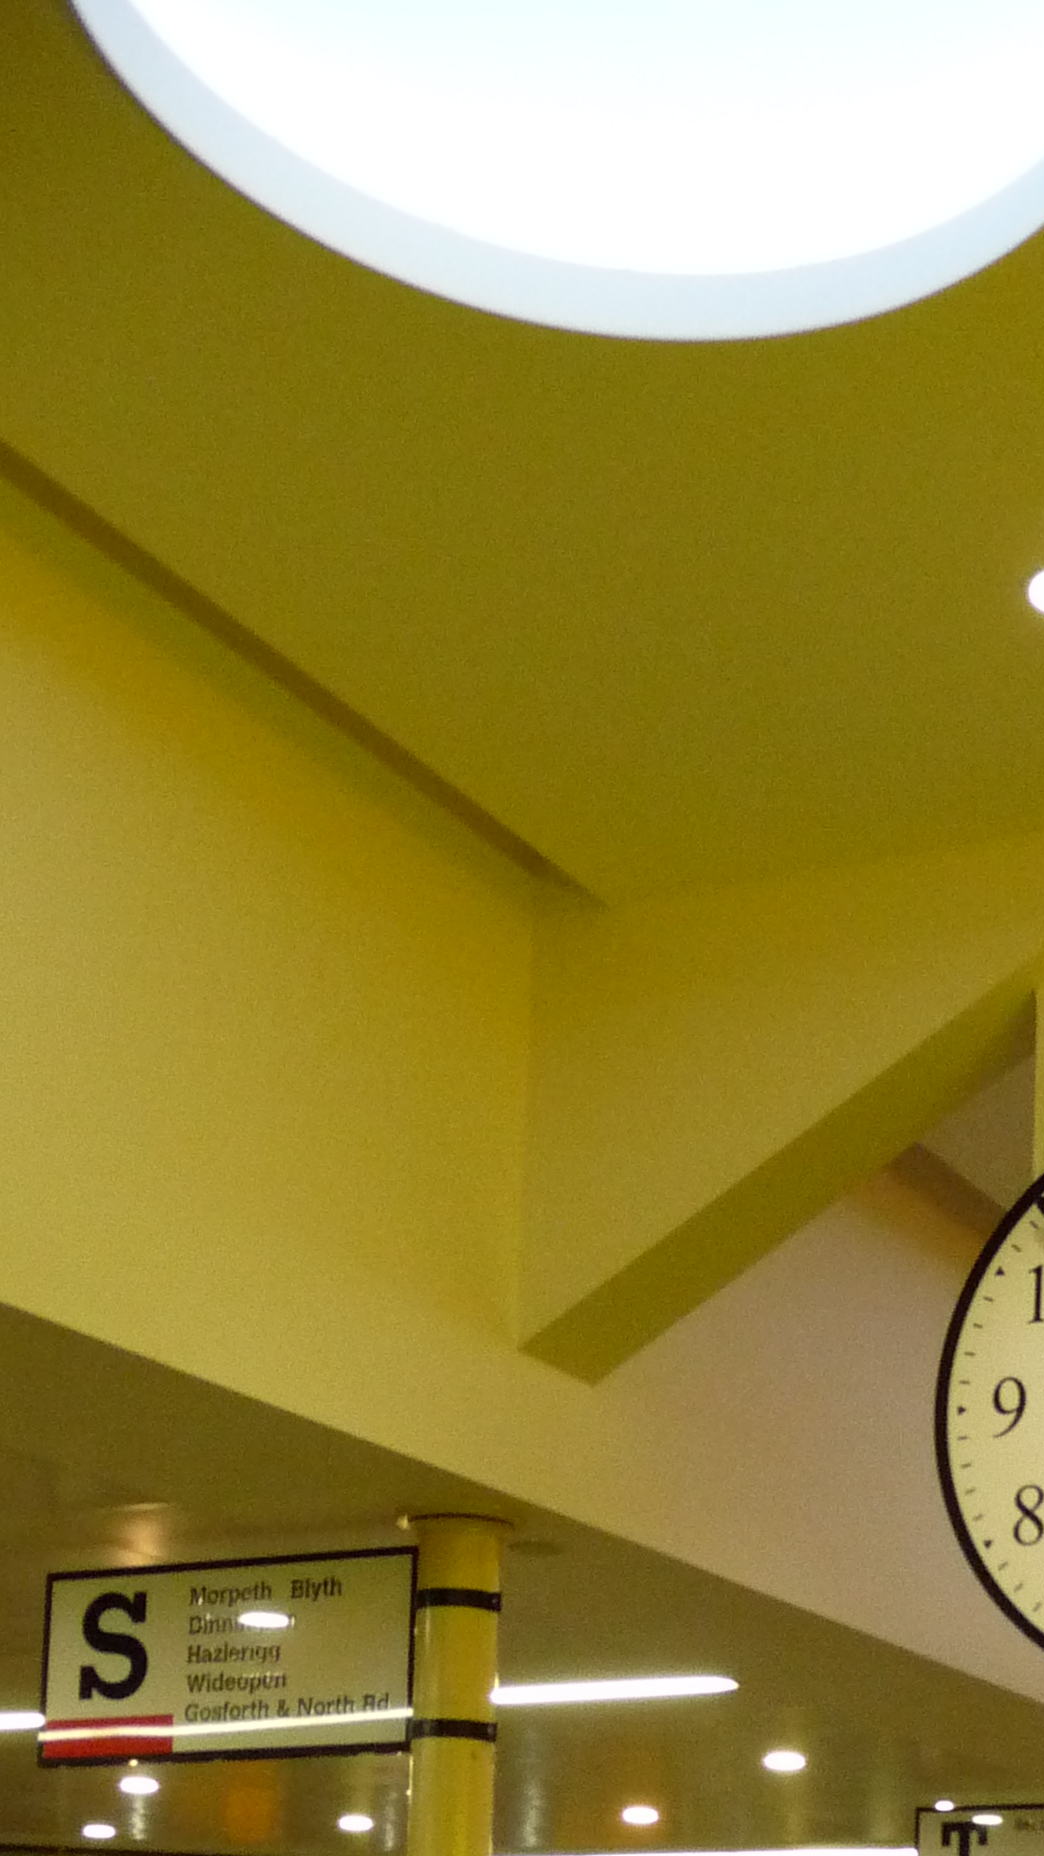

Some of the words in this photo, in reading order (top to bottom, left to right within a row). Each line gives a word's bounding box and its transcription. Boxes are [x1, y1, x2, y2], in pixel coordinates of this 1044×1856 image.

[991, 1376, 1027, 1438] 9
[189, 1580, 272, 1608] Morpeth
[290, 1575, 343, 1602] Blyth
[78, 1591, 149, 1700] S
[186, 1641, 281, 1665] Hazlerigg
[186, 1671, 287, 1695] Wideopen
[184, 1699, 270, 1723] Gosforth
[276, 1698, 290, 1718] &
[296, 1695, 354, 1717] North
[362, 1691, 390, 1712] Rd
